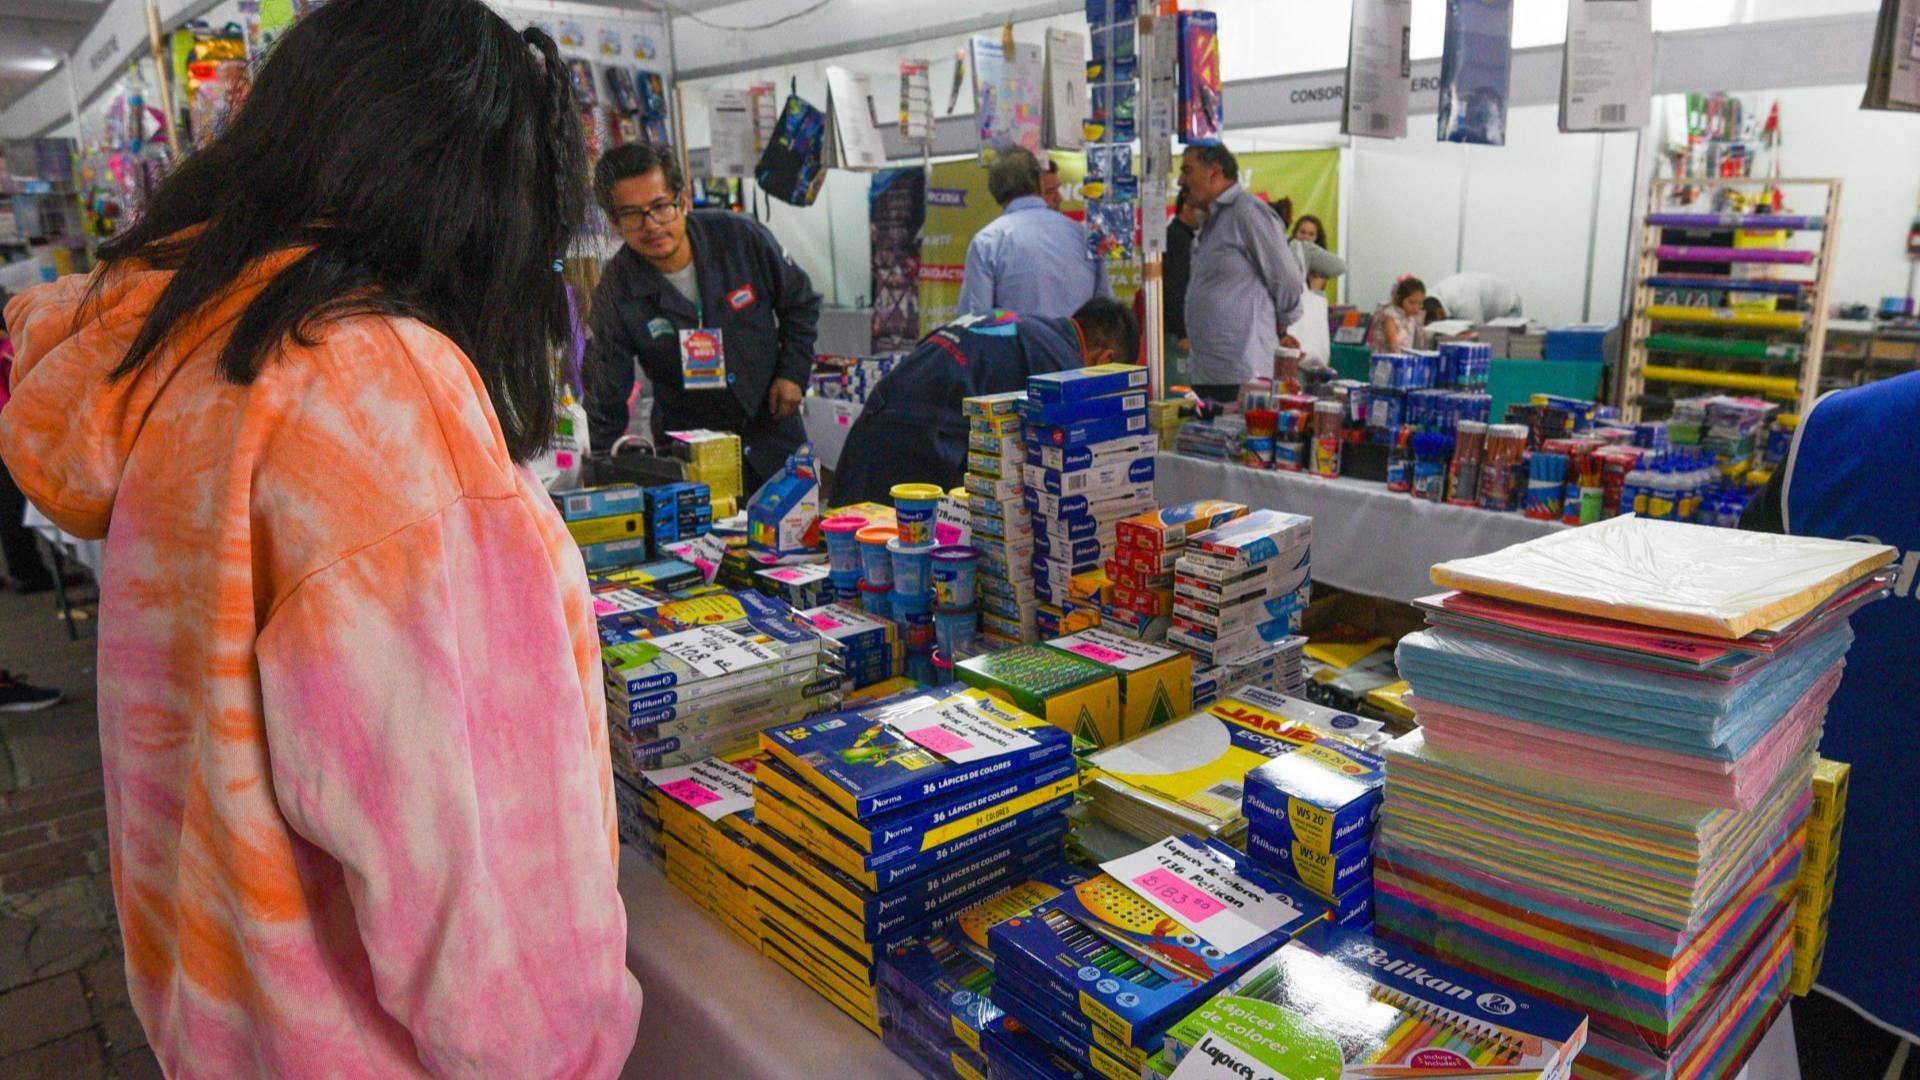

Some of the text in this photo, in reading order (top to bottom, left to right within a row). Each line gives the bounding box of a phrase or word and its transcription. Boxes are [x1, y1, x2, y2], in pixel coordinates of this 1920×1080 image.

[1290, 77, 1440, 103] CONSOR ERO
[631, 678, 662, 692] Pelikan
[632, 698, 663, 711] Pelikan
[630, 713, 661, 729] Pelikan
[1212, 705, 1321, 744] JANE
[785, 727, 812, 741] 36
[923, 760, 1012, 795] 36 LÁPICES DE COLORES
[871, 794, 902, 812] Norma
[933, 785, 1018, 823] 36 LÁPICES DE COLORES
[1247, 794, 1276, 815] Pelikan
[1296, 805, 1313, 820] WS
[985, 807, 1010, 822] COLORES
[883, 825, 913, 844] Norma
[936, 820, 1018, 861] 36 LÁPICES DE COLORES
[1335, 823, 1359, 840] Pelikan
[1251, 834, 1280, 856] Pelikan
[1299, 845, 1315, 861] WS
[889, 863, 917, 882] Norma
[927, 849, 1011, 891] 36 LÁPICES DE COLORES
[924, 867, 1006, 911] 36 LÁPICES DE COLORES
[1190, 873, 1245, 909] Pelikan
[1203, 865, 1219, 878] de
[1219, 874, 1265, 904] colores
[879, 895, 907, 914] Norma
[877, 914, 905, 934] Norma
[1352, 943, 1475, 1001] Pelikan
[1200, 1009, 1223, 1024] de
[1225, 1021, 1290, 1055] colores
